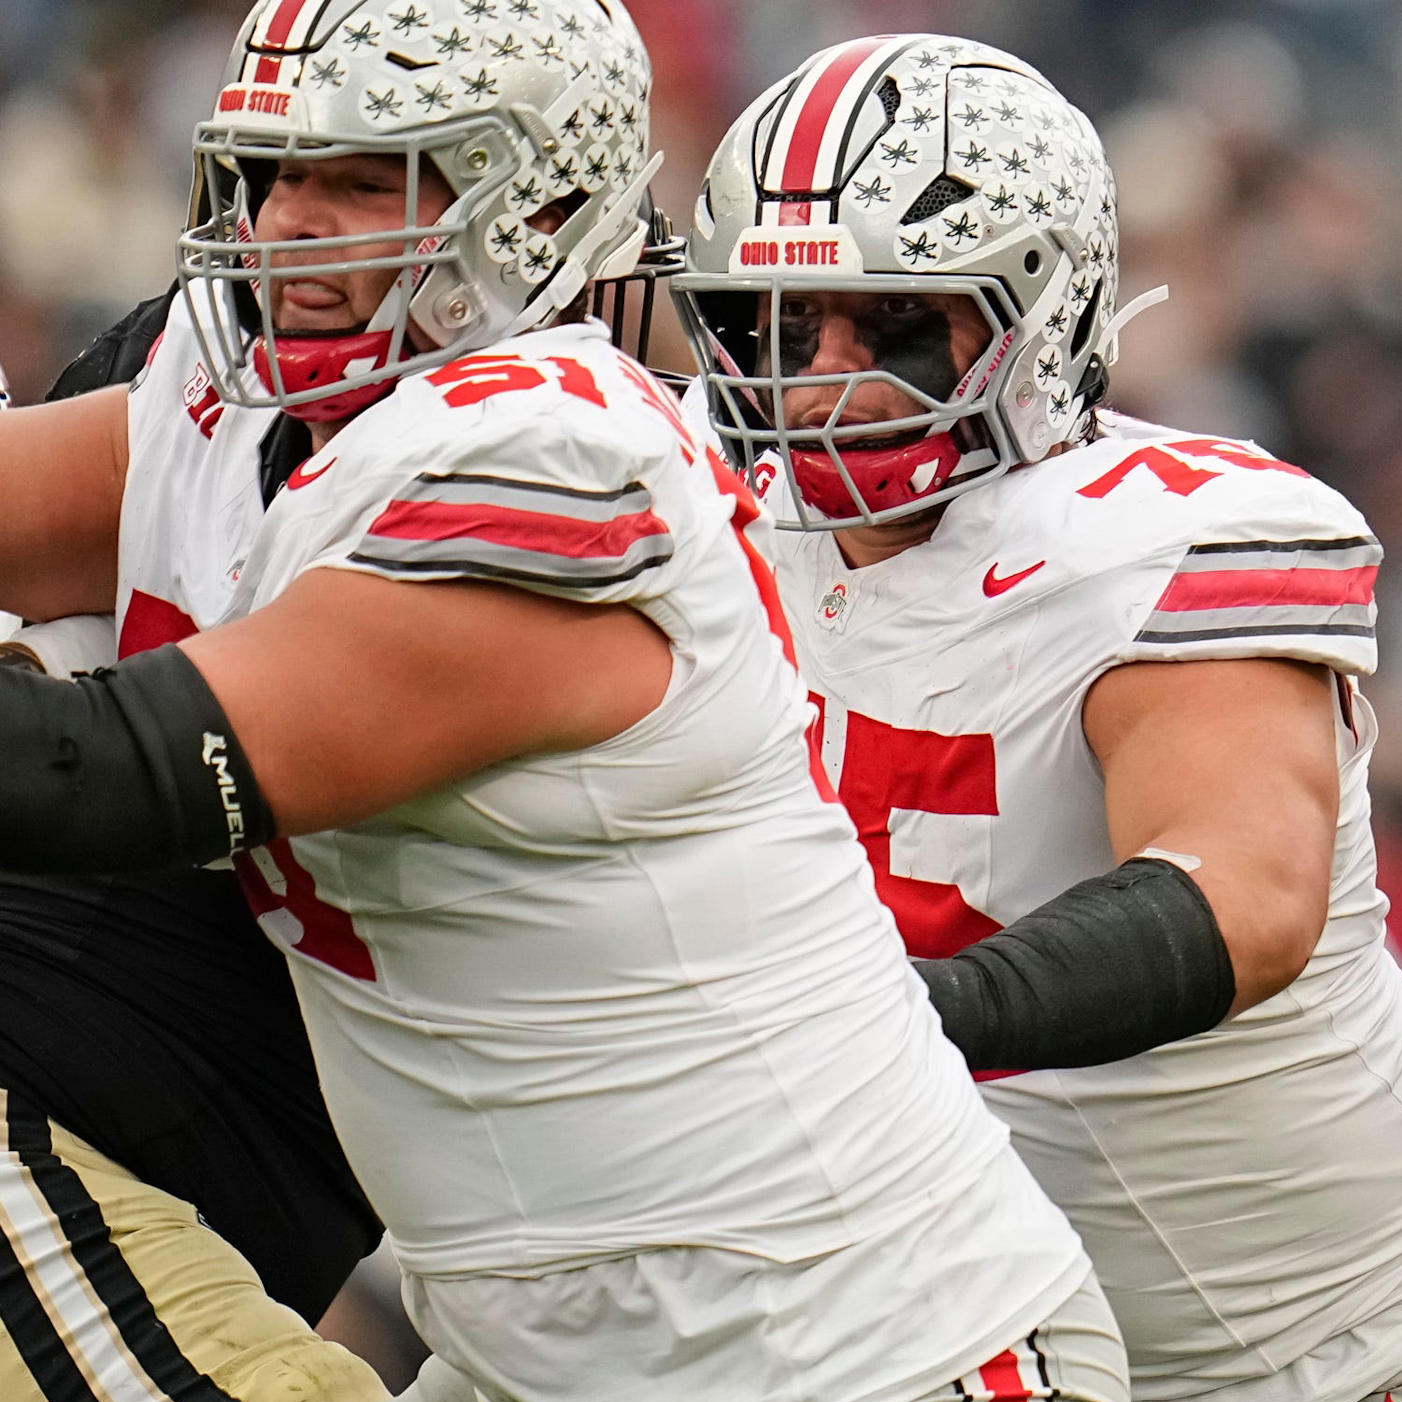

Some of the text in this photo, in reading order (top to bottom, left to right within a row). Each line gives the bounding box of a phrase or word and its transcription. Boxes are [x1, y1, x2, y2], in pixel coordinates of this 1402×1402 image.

[248, 90, 291, 117] STATE
[740, 240, 839, 266] OHIO STATE
[424, 354, 608, 409] 51
